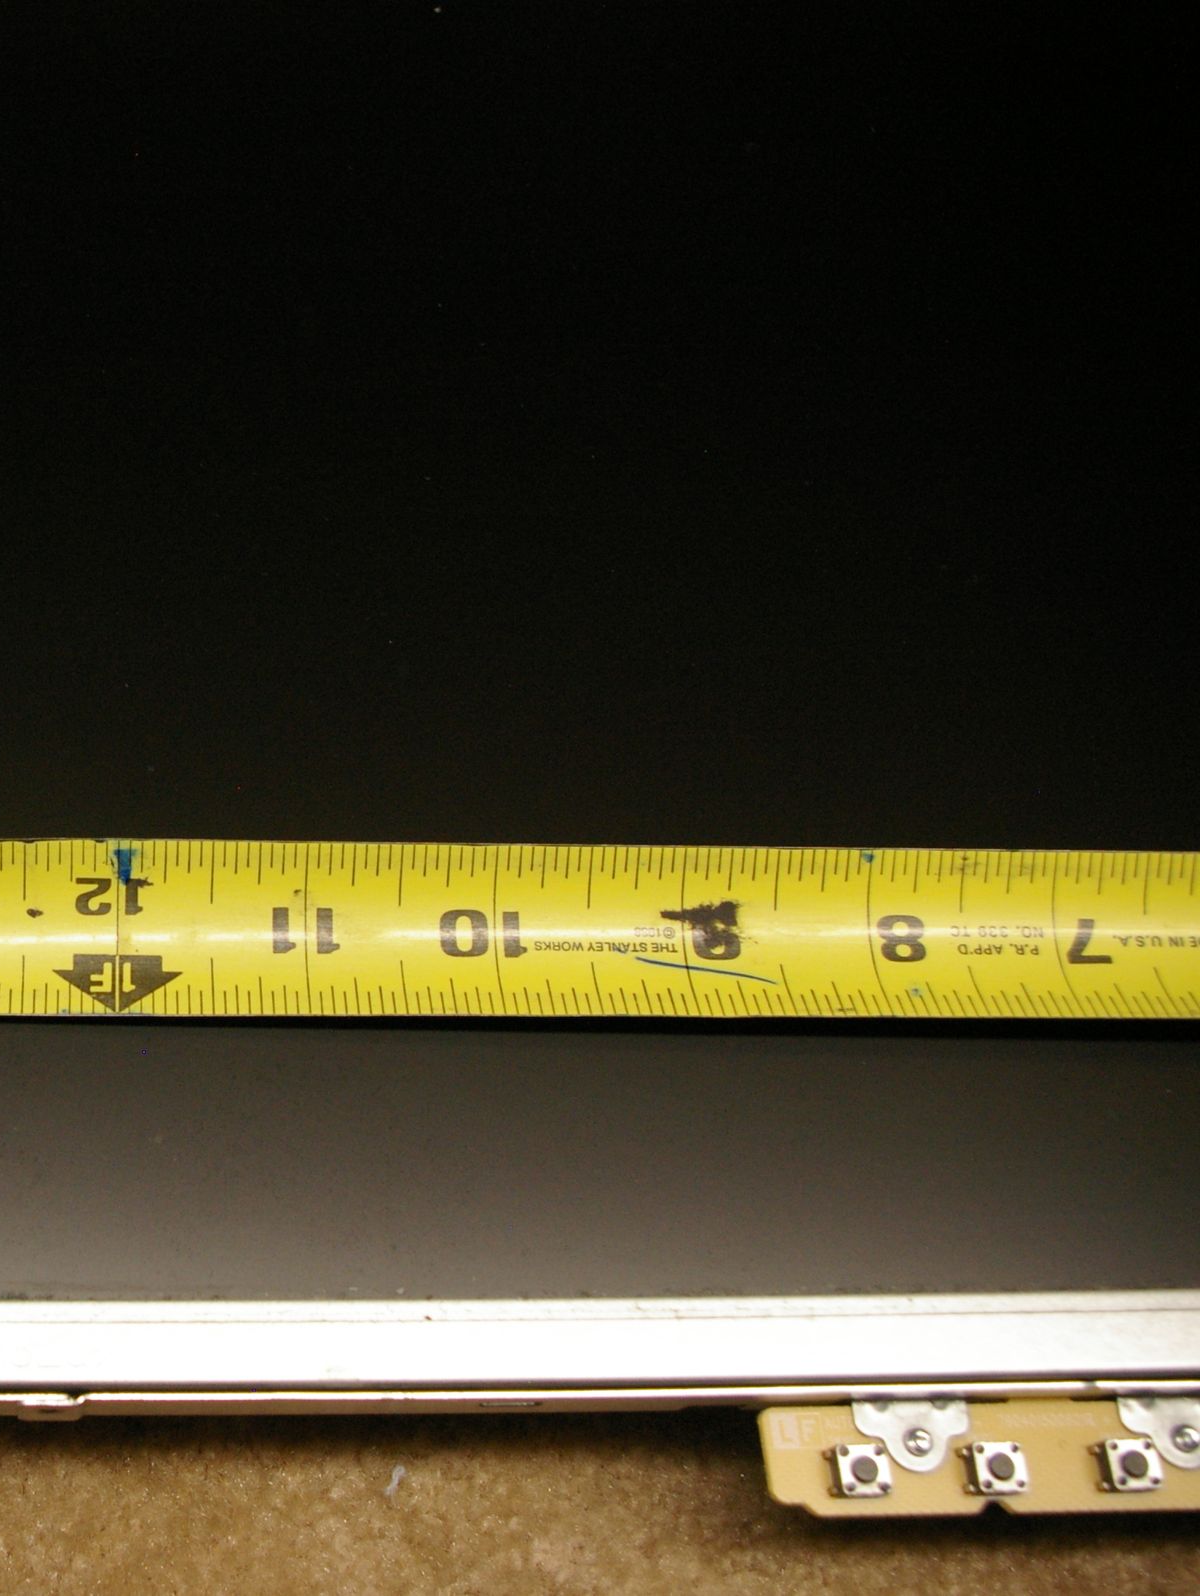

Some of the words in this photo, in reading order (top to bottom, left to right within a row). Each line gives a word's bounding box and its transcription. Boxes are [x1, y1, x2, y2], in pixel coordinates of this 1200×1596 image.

[75, 877, 145, 916] 12
[272, 906, 341, 954] 11
[439, 908, 529, 958] 10
[1015, 925, 1045, 939] NO.
[876, 914, 927, 963] 8
[1066, 917, 1114, 965] 7
[1112, 934, 1163, 948] U.S.A.
[1167, 935, 1185, 948] IN
[534, 941, 584, 952] WORKS
[587, 941, 648, 953] STANLEY
[651, 942, 678, 953] THE
[957, 943, 1003, 956] APP'D
[1009, 943, 1040, 956] P.R.
